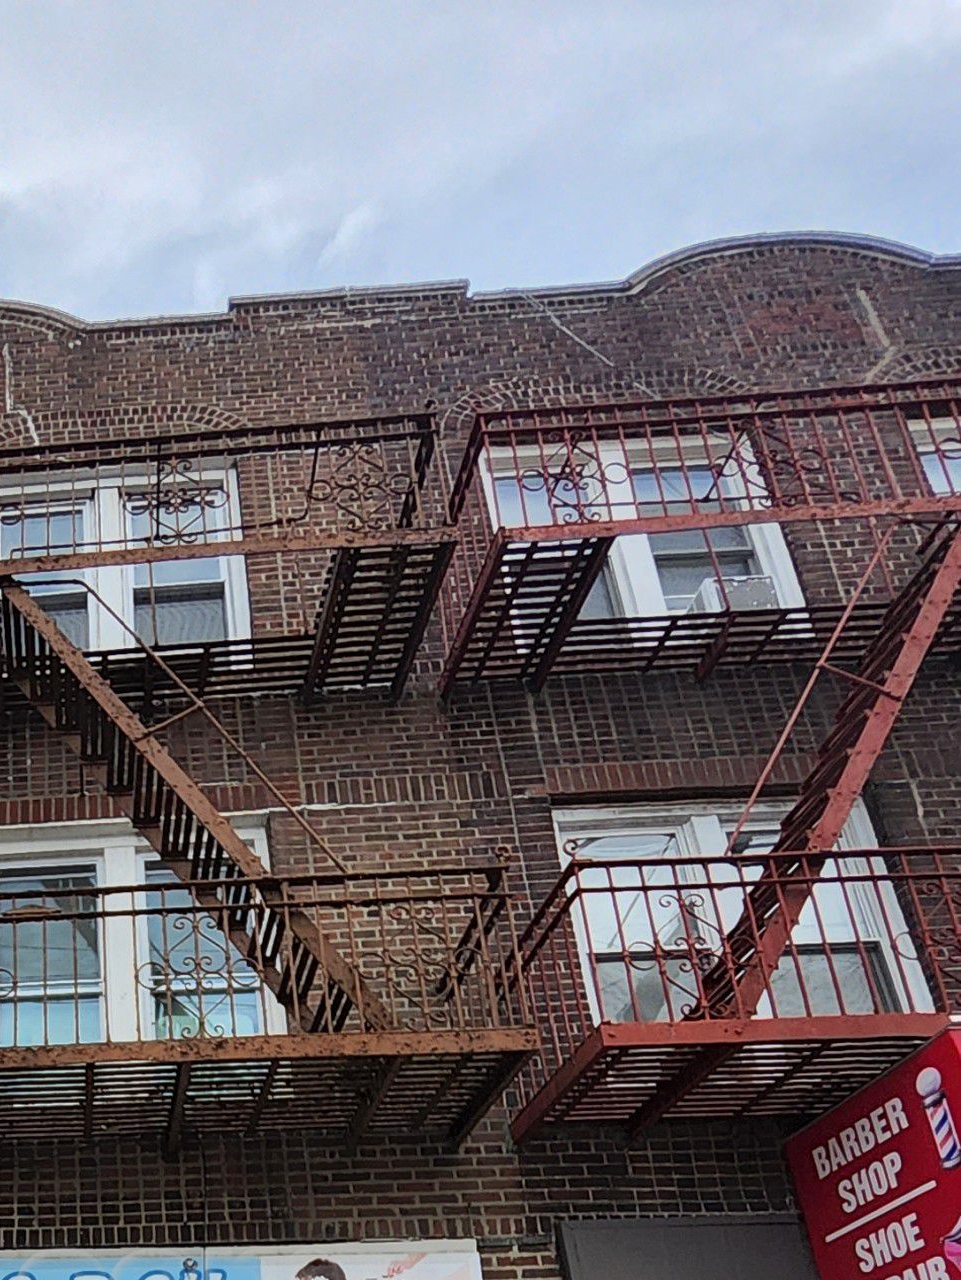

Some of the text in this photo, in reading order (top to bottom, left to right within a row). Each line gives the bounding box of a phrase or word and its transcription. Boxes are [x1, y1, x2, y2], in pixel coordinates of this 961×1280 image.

[812, 1098, 909, 1179] BARBER
[839, 1152, 902, 1213] SHOP
[855, 1213, 925, 1273] SHOE
